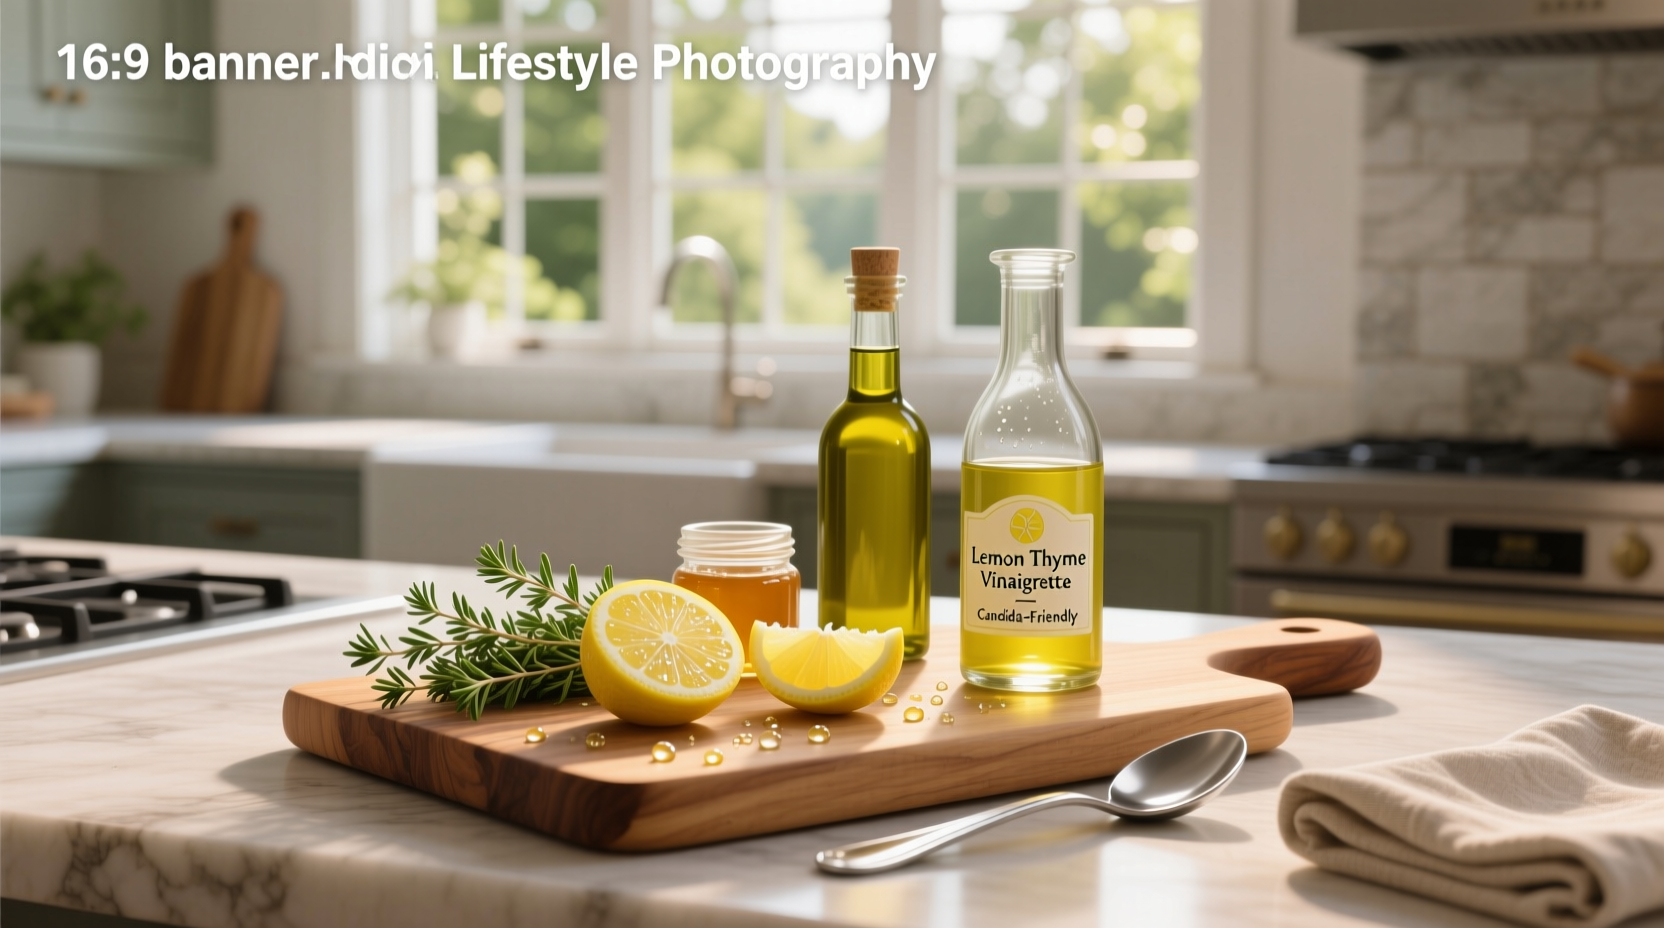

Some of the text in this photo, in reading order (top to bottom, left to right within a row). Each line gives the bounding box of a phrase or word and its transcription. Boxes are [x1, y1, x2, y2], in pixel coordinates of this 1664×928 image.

[972, 546, 1086, 573] Lemon Thyme
[980, 570, 1072, 594] Vinaigrette
[977, 608, 1078, 626] Candida-Friendly
